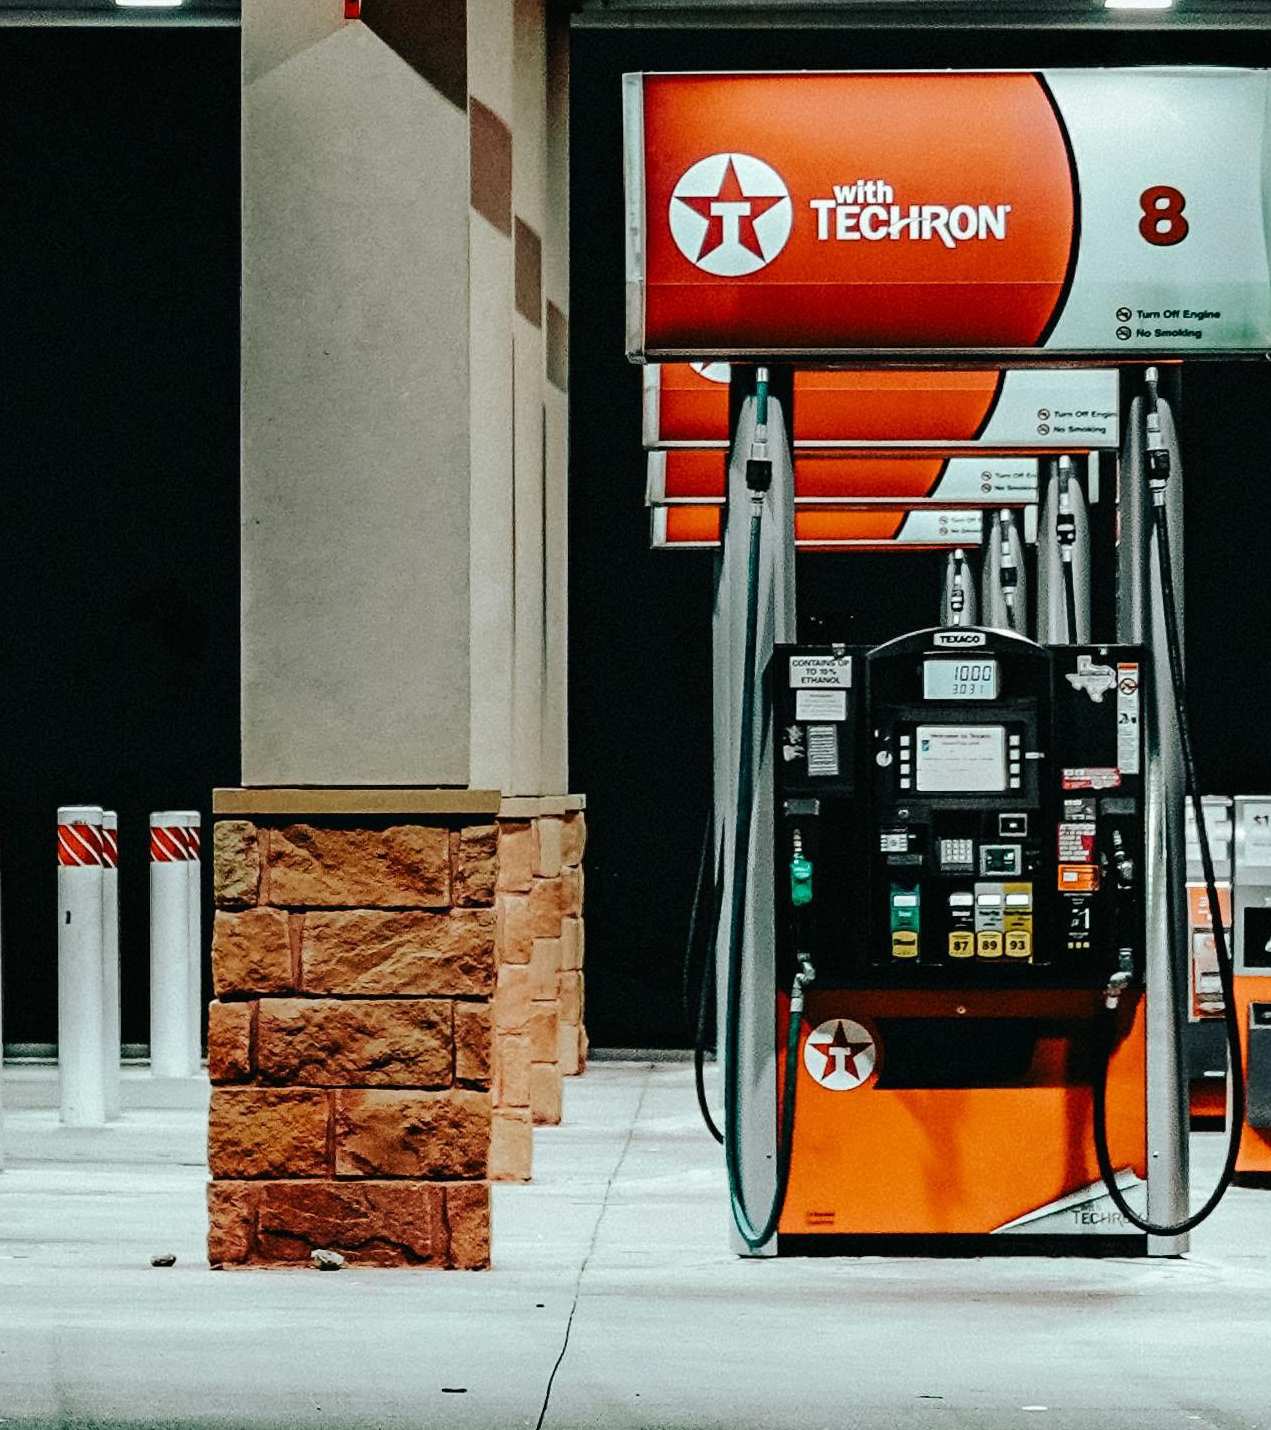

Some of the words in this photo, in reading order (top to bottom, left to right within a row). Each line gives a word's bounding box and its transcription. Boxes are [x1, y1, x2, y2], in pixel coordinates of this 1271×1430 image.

[833, 179, 894, 204] with
[1139, 186, 1189, 246] 8
[809, 199, 1008, 249] TECHRON
[1136, 310, 1160, 318] Turn
[1163, 310, 1180, 318] Off
[1183, 310, 1221, 321] Engine
[1136, 329, 1152, 338] No
[1154, 329, 1203, 340] Smoking
[1091, 411, 1118, 419] Engin
[940, 635, 980, 644] TEXACO
[792, 659, 836, 668] CONTAINS
[953, 940, 969, 951] 87
[982, 940, 998, 951] 89
[1009, 940, 1026, 951] 93
[1071, 1209, 1146, 1227] TECHR
